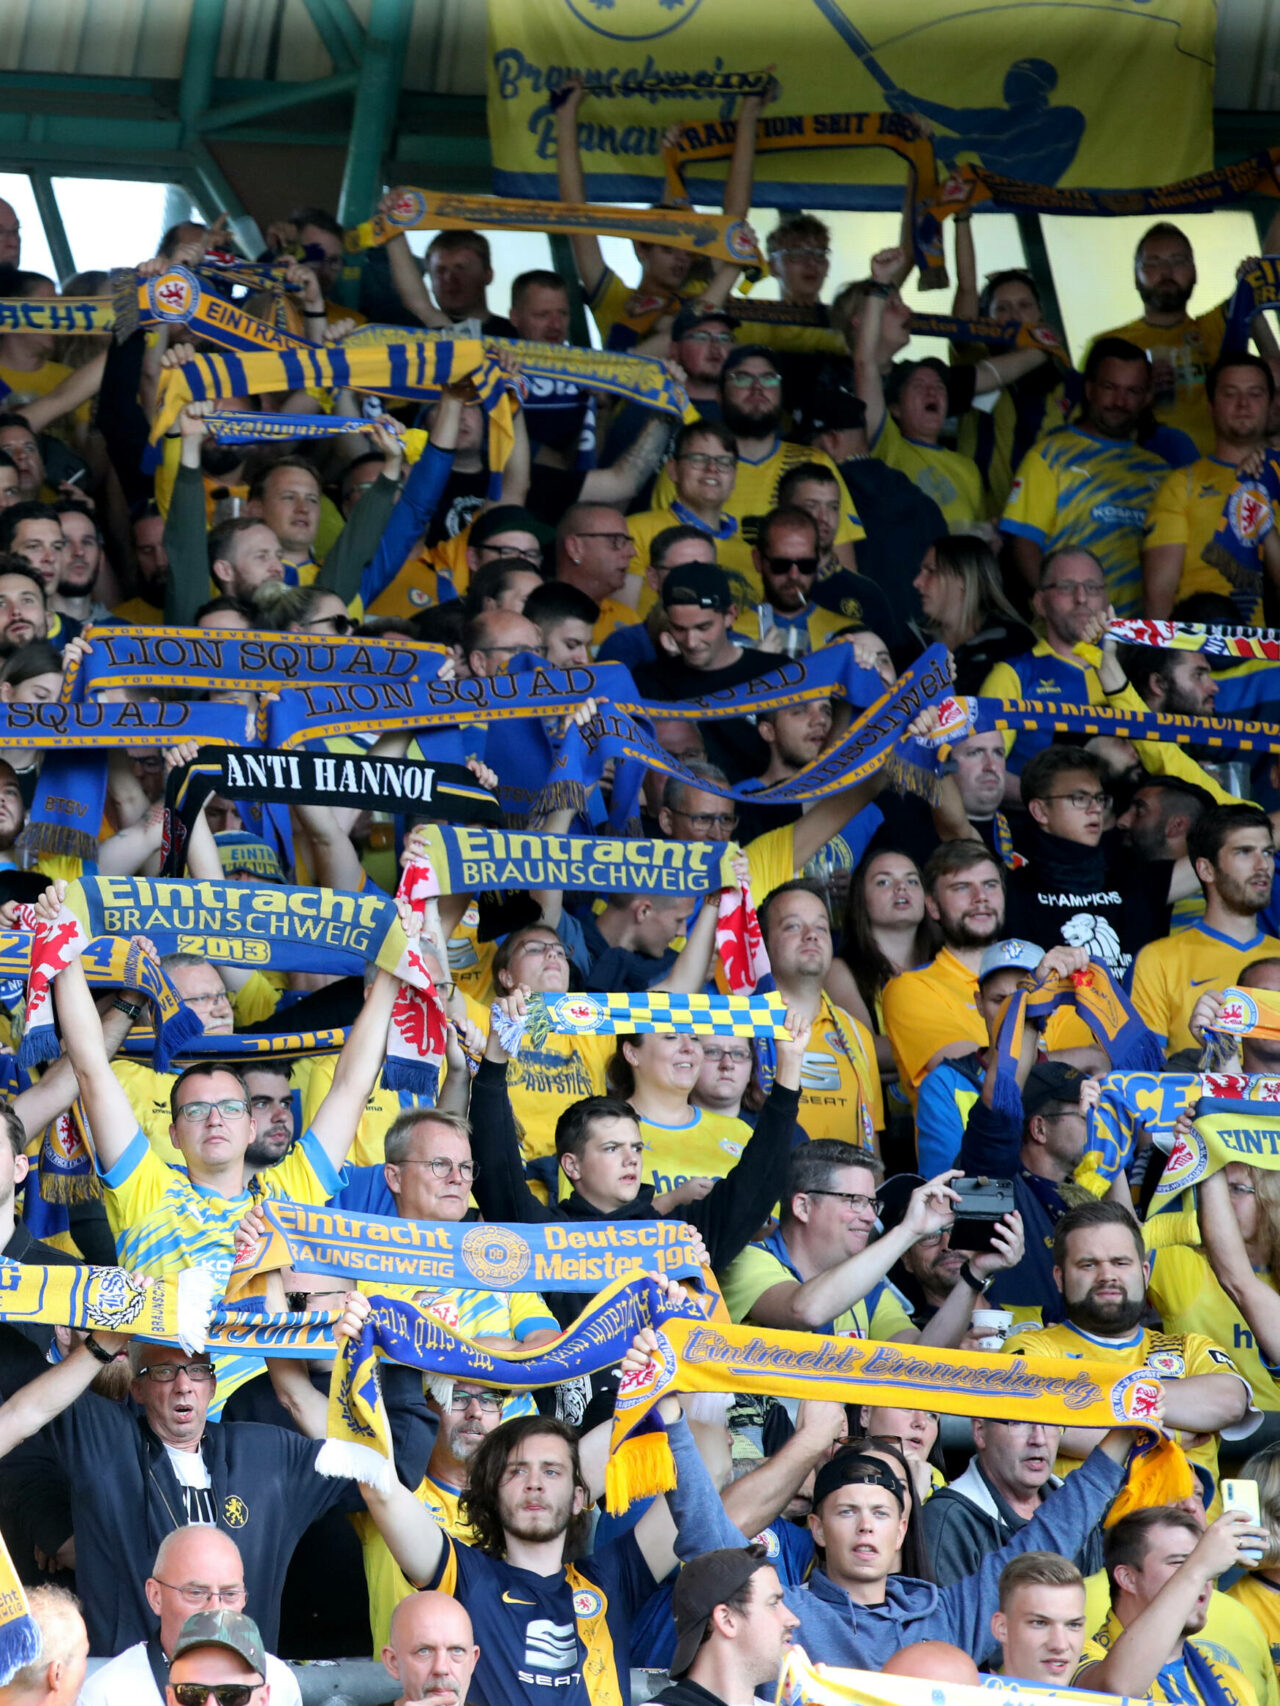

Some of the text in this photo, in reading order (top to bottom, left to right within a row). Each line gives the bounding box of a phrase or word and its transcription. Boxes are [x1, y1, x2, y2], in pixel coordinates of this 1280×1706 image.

[812, 112, 871, 136] SEIT
[106, 628, 410, 647] YOU'LL NEVER WALK ALONE
[96, 635, 419, 678] LION SQUAD
[296, 666, 597, 718] LION SQUAD
[6, 701, 192, 735] SQUAD
[320, 718, 385, 735] YOU'LL
[401, 713, 457, 726] NEVER
[471, 709, 515, 719] WALK
[52, 737, 101, 746] WALK
[116, 735, 176, 744] ALONE
[227, 754, 436, 803] ANTI HANNOI
[43, 796, 89, 818] BTSV
[453, 827, 714, 871] Eintracht
[463, 861, 710, 891] BRAUNSCHWEIG
[93, 876, 386, 928] Eintracht
[104, 910, 370, 951] BRAUNSCHWEIG
[178, 935, 270, 963] 2013
[276, 1201, 454, 1250] Eintracht
[533, 1249, 643, 1281] Meister
[680, 1327, 869, 1372] Eintracht
[859, 1345, 1105, 1409] Braunschweig
